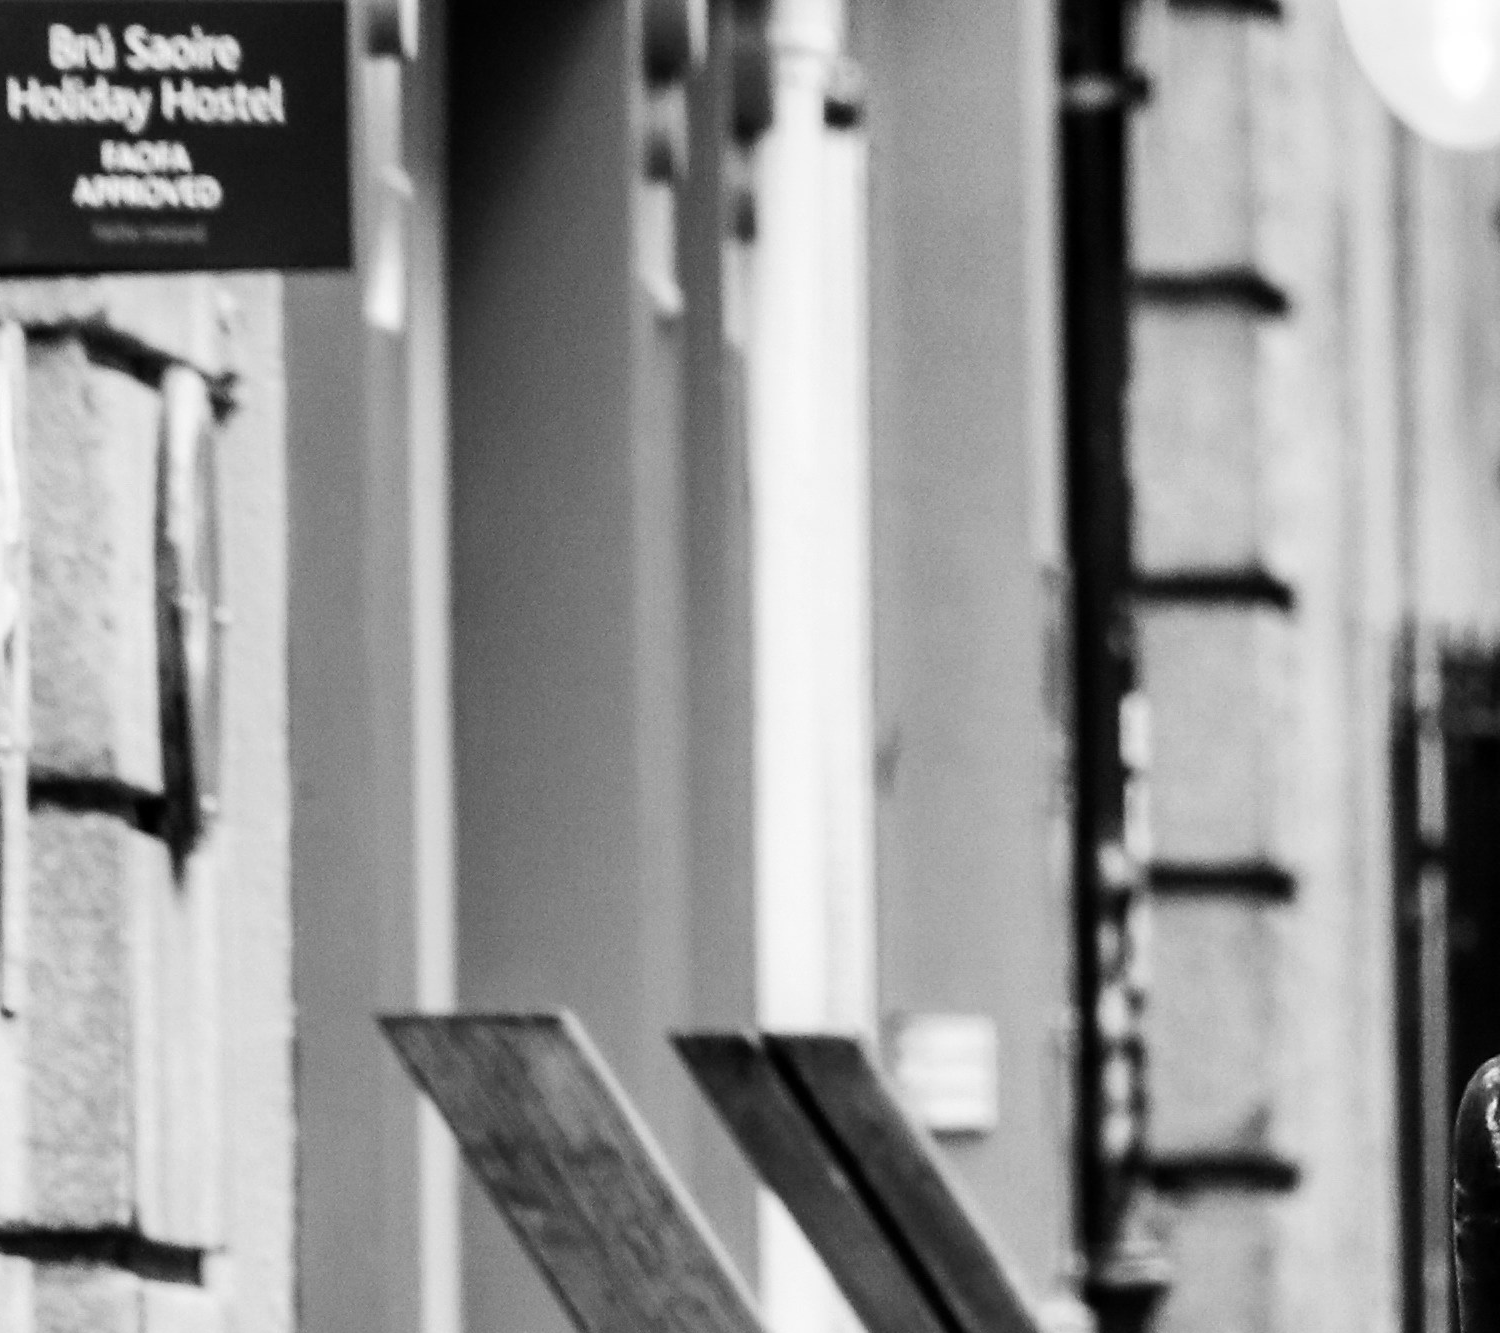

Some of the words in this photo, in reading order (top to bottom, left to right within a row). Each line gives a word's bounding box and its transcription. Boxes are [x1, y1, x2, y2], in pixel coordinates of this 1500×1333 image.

[123, 24, 242, 72] Saoire
[6, 75, 153, 134] Holiday
[160, 75, 286, 124] Hostel
